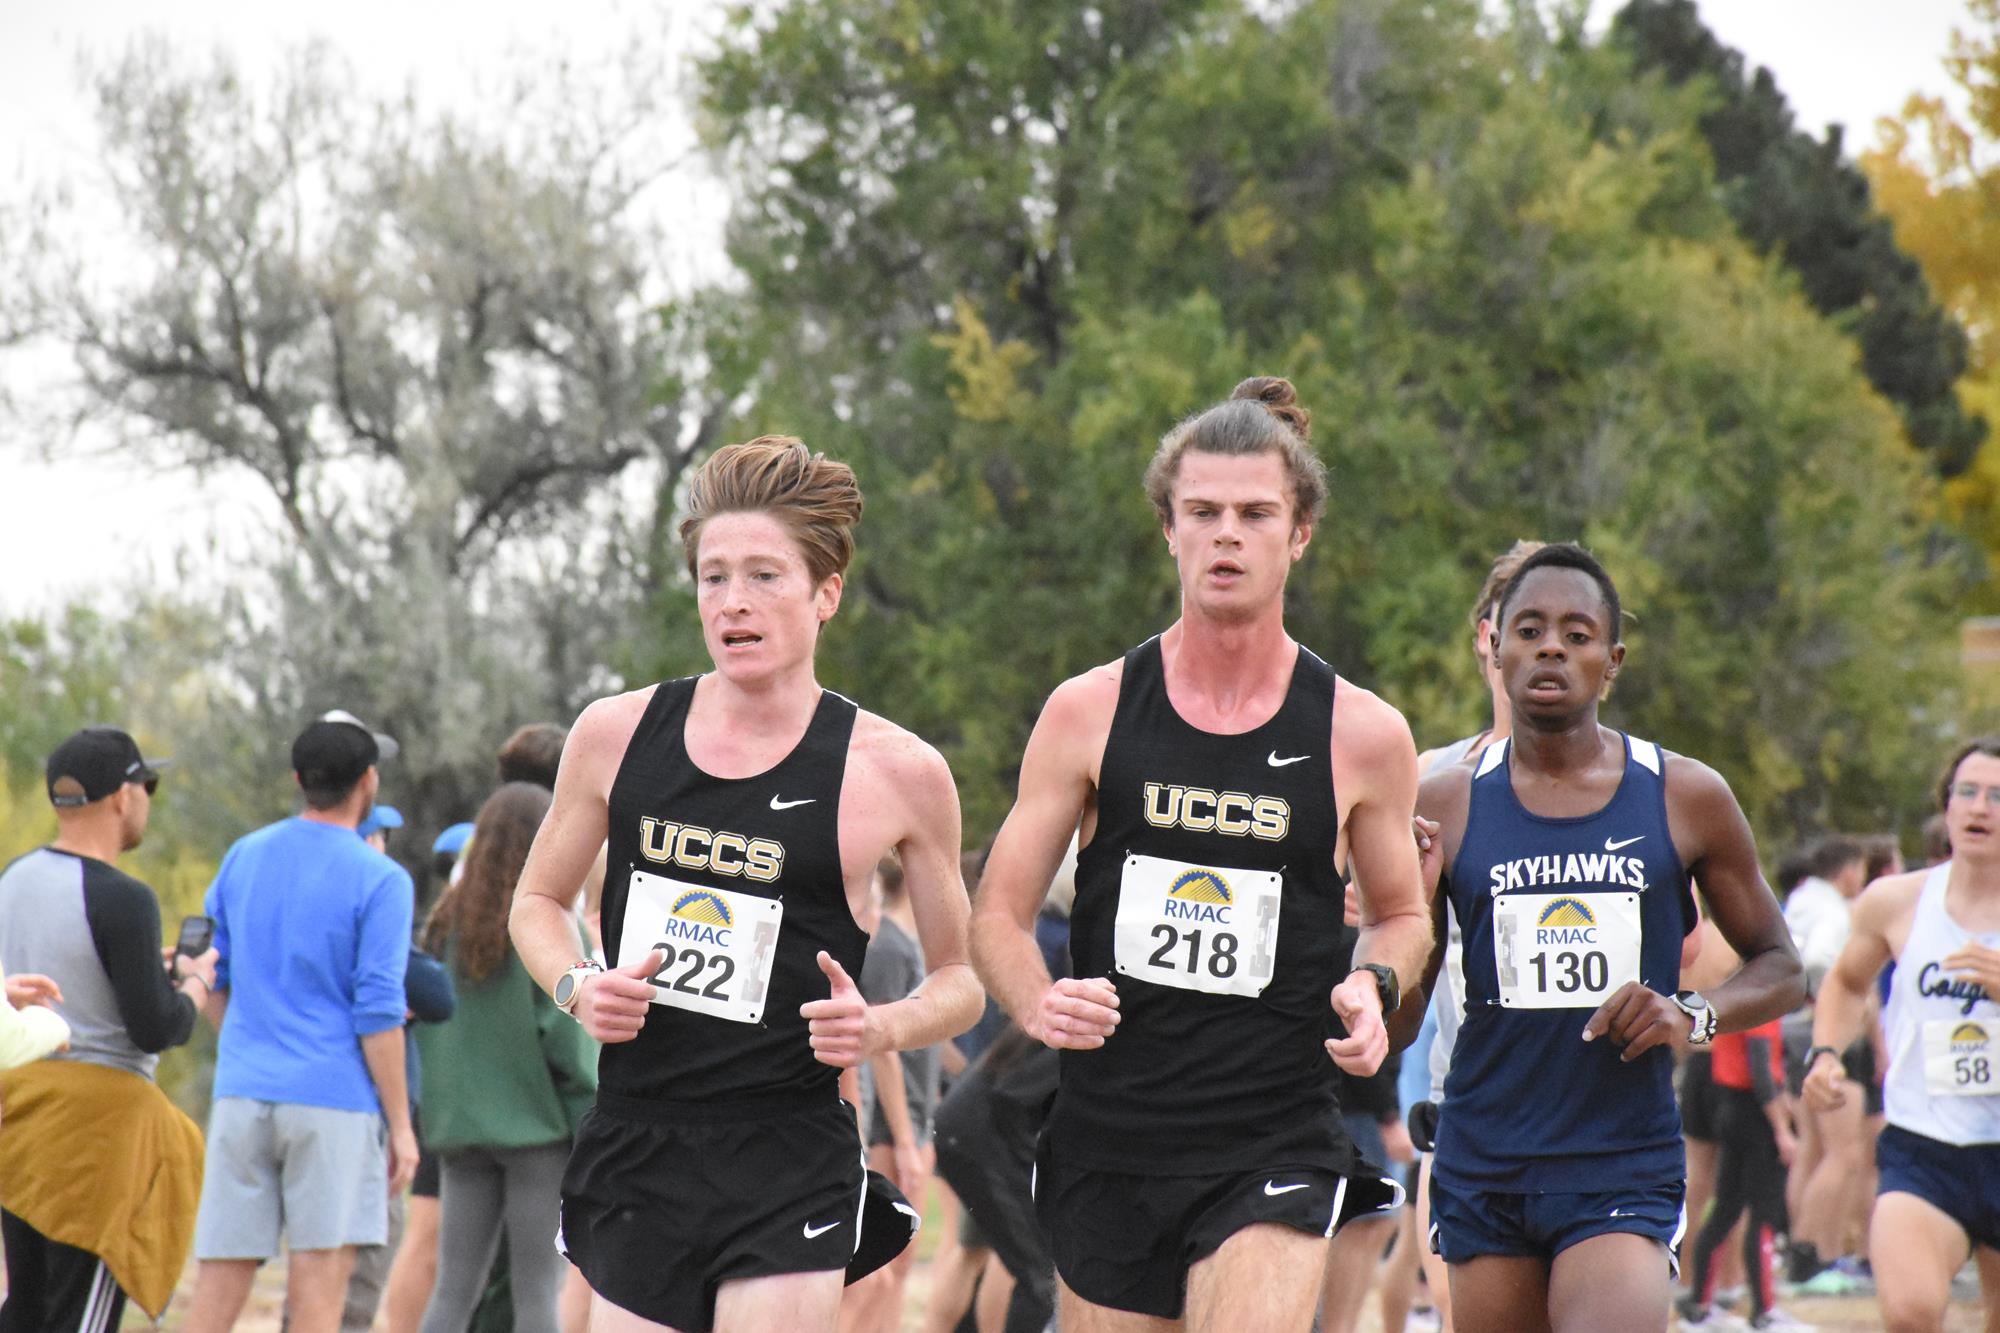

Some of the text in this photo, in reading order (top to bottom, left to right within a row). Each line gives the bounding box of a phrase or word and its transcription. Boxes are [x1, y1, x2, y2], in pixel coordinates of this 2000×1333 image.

[1144, 782, 1291, 842] UCCS
[639, 816, 785, 883] UCCS
[1490, 853, 1646, 894] SKYHAWKS
[1164, 899, 1231, 924] RMAC
[665, 918, 732, 947] RMAC
[1148, 923, 1239, 979] 218
[1536, 928, 1597, 945] RMAC
[646, 942, 735, 1002] 222
[1529, 951, 1609, 993] 130
[1954, 1057, 1991, 1085] 58
